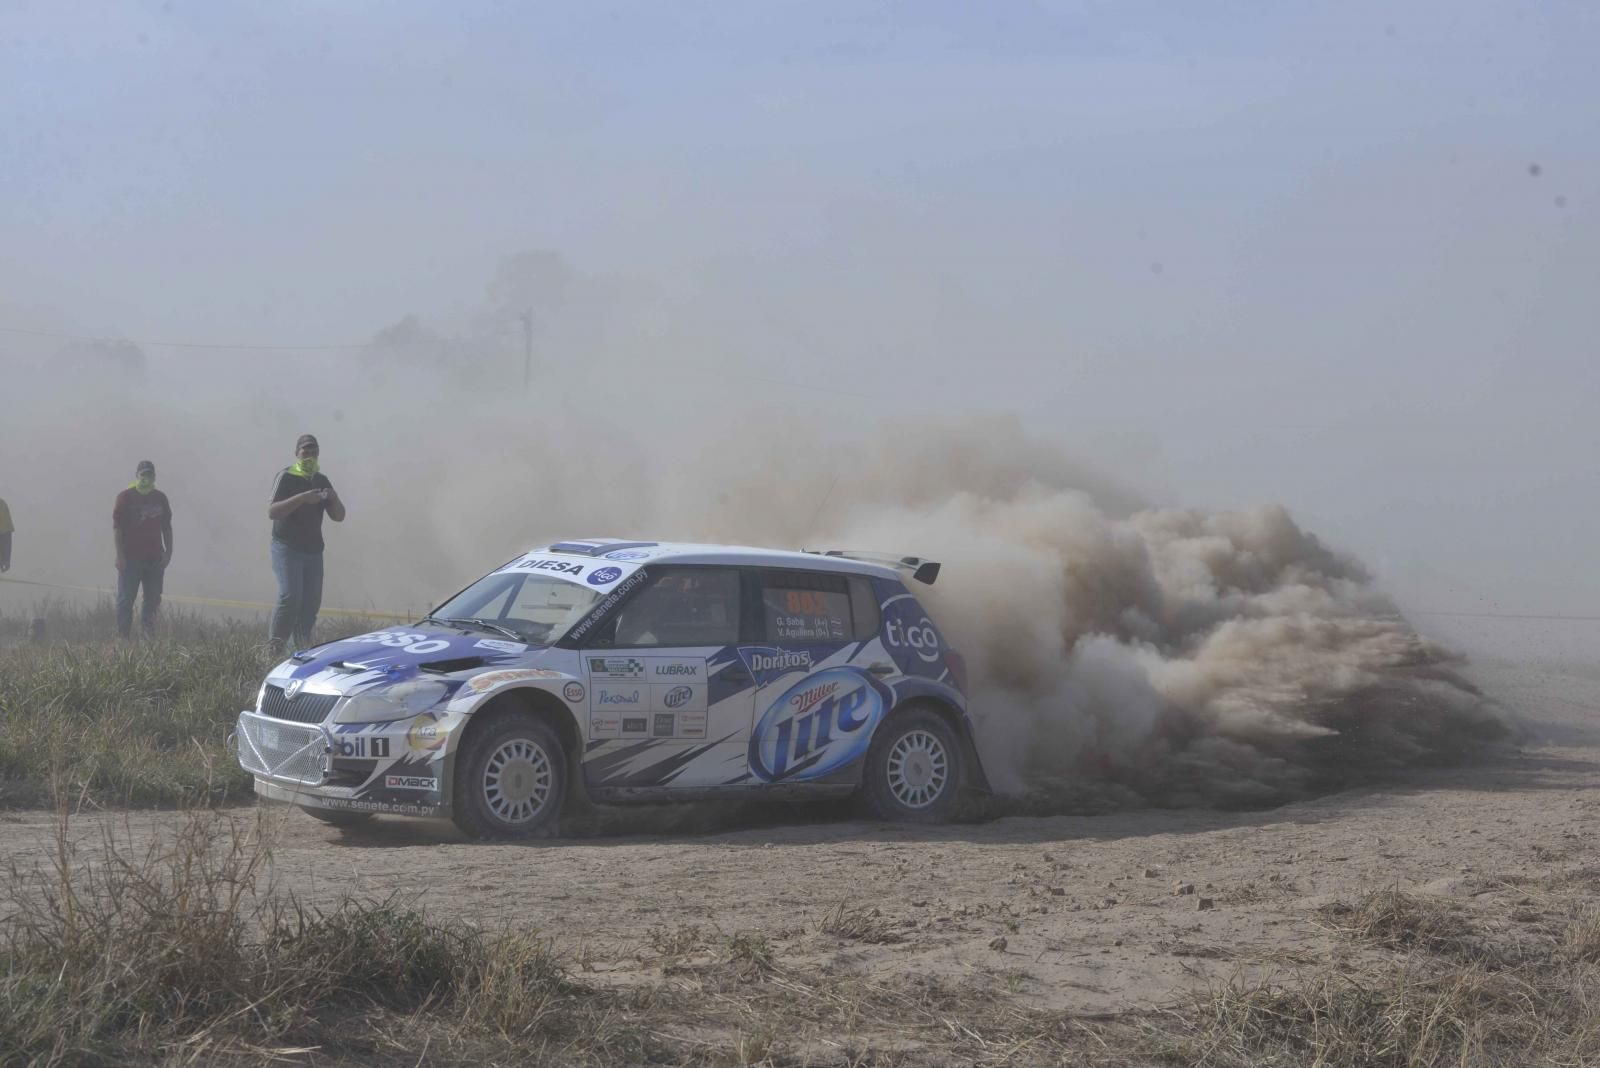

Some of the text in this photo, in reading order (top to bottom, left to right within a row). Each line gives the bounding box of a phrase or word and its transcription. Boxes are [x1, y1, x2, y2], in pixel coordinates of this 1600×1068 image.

[516, 560, 584, 576] DIESA
[570, 566, 649, 641] www.senete.com.py
[656, 665, 697, 676] LUBRAX
[752, 652, 809, 672] Doritos
[791, 681, 839, 715] Miller
[341, 737, 365, 757] bil
[321, 797, 434, 816] www.senete.com.py
